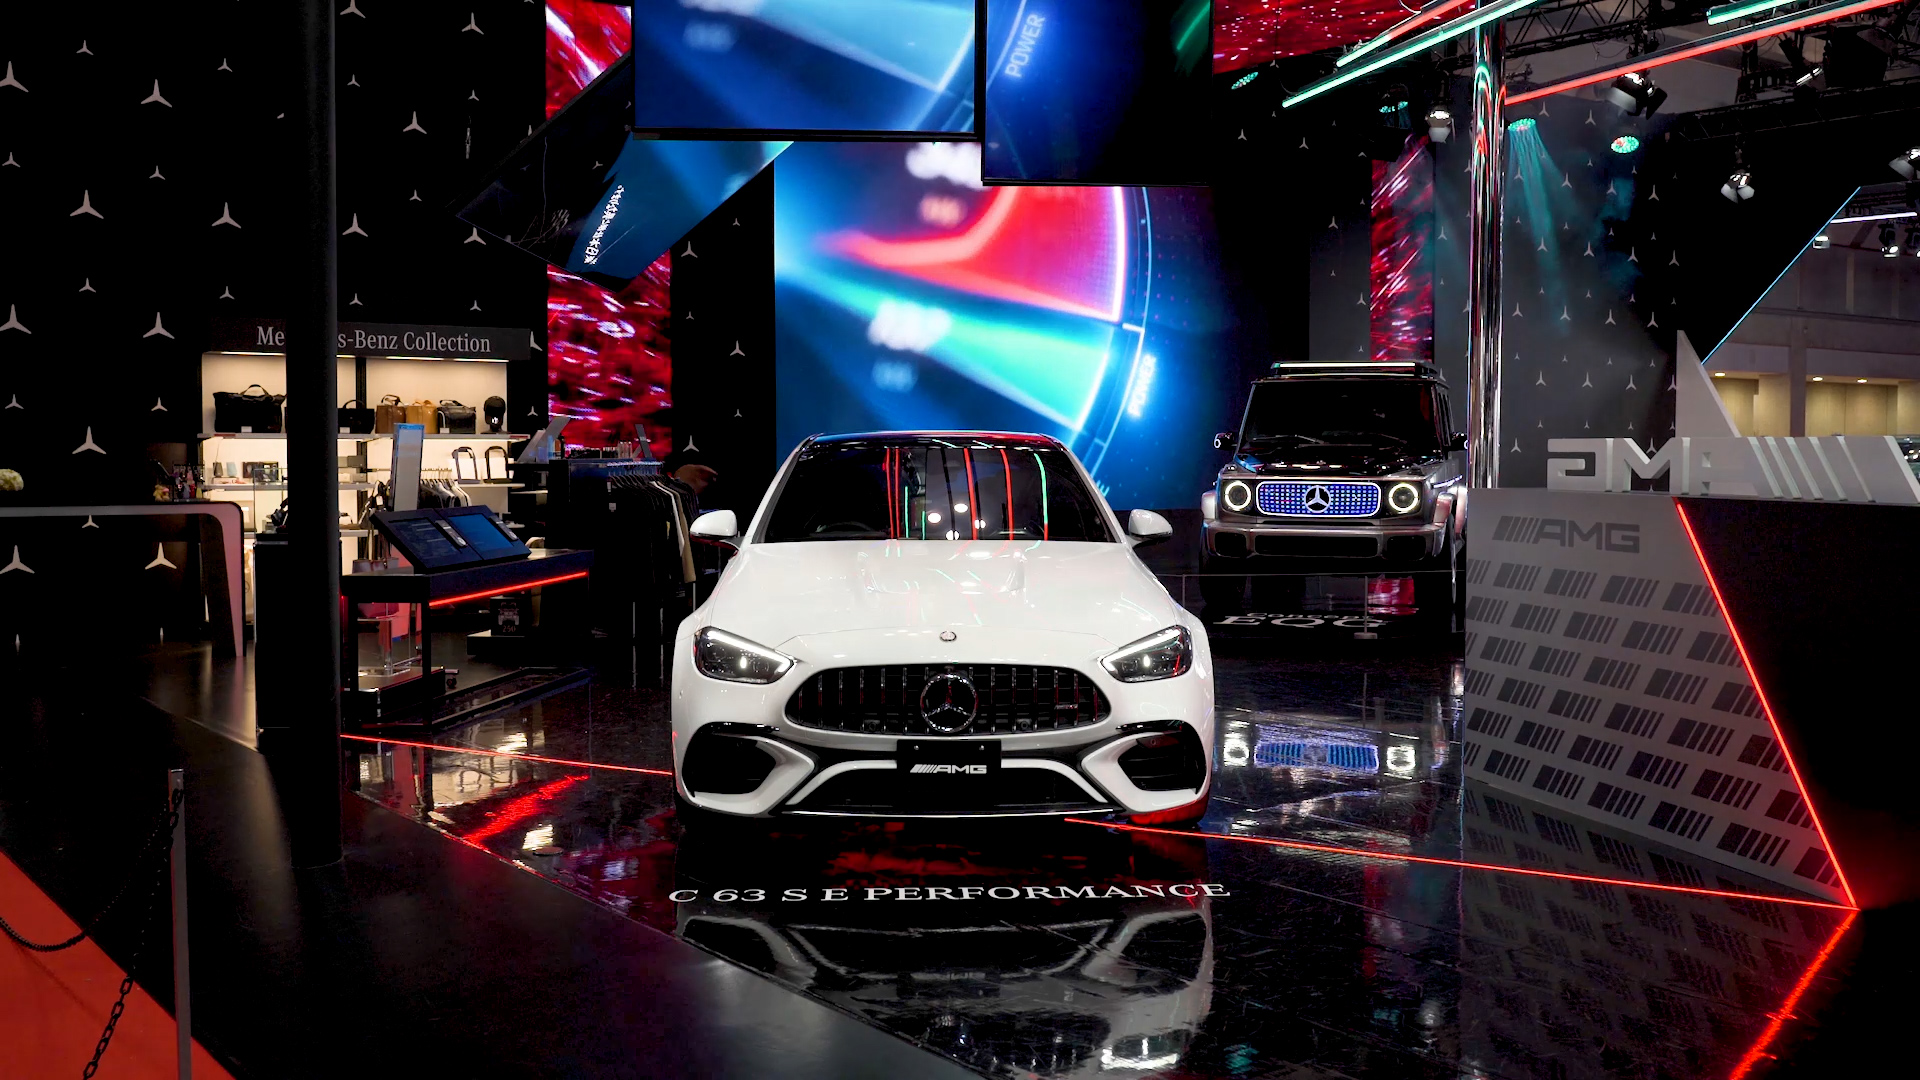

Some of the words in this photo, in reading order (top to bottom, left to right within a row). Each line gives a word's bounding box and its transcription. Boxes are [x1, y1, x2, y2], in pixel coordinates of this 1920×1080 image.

[1004, 13, 1046, 78] POWER
[257, 325, 399, 350] Mes-Benz
[403, 331, 491, 352] Collection
[1126, 353, 1158, 418] POWER
[1531, 517, 1641, 554] AMG
[1212, 615, 1387, 629] EQG
[933, 764, 988, 775] AMG
[668, 889, 699, 902] C
[712, 888, 766, 902] 63
[781, 888, 808, 902] S
[820, 887, 849, 902] E
[863, 883, 1231, 901] PERFORMANCE
